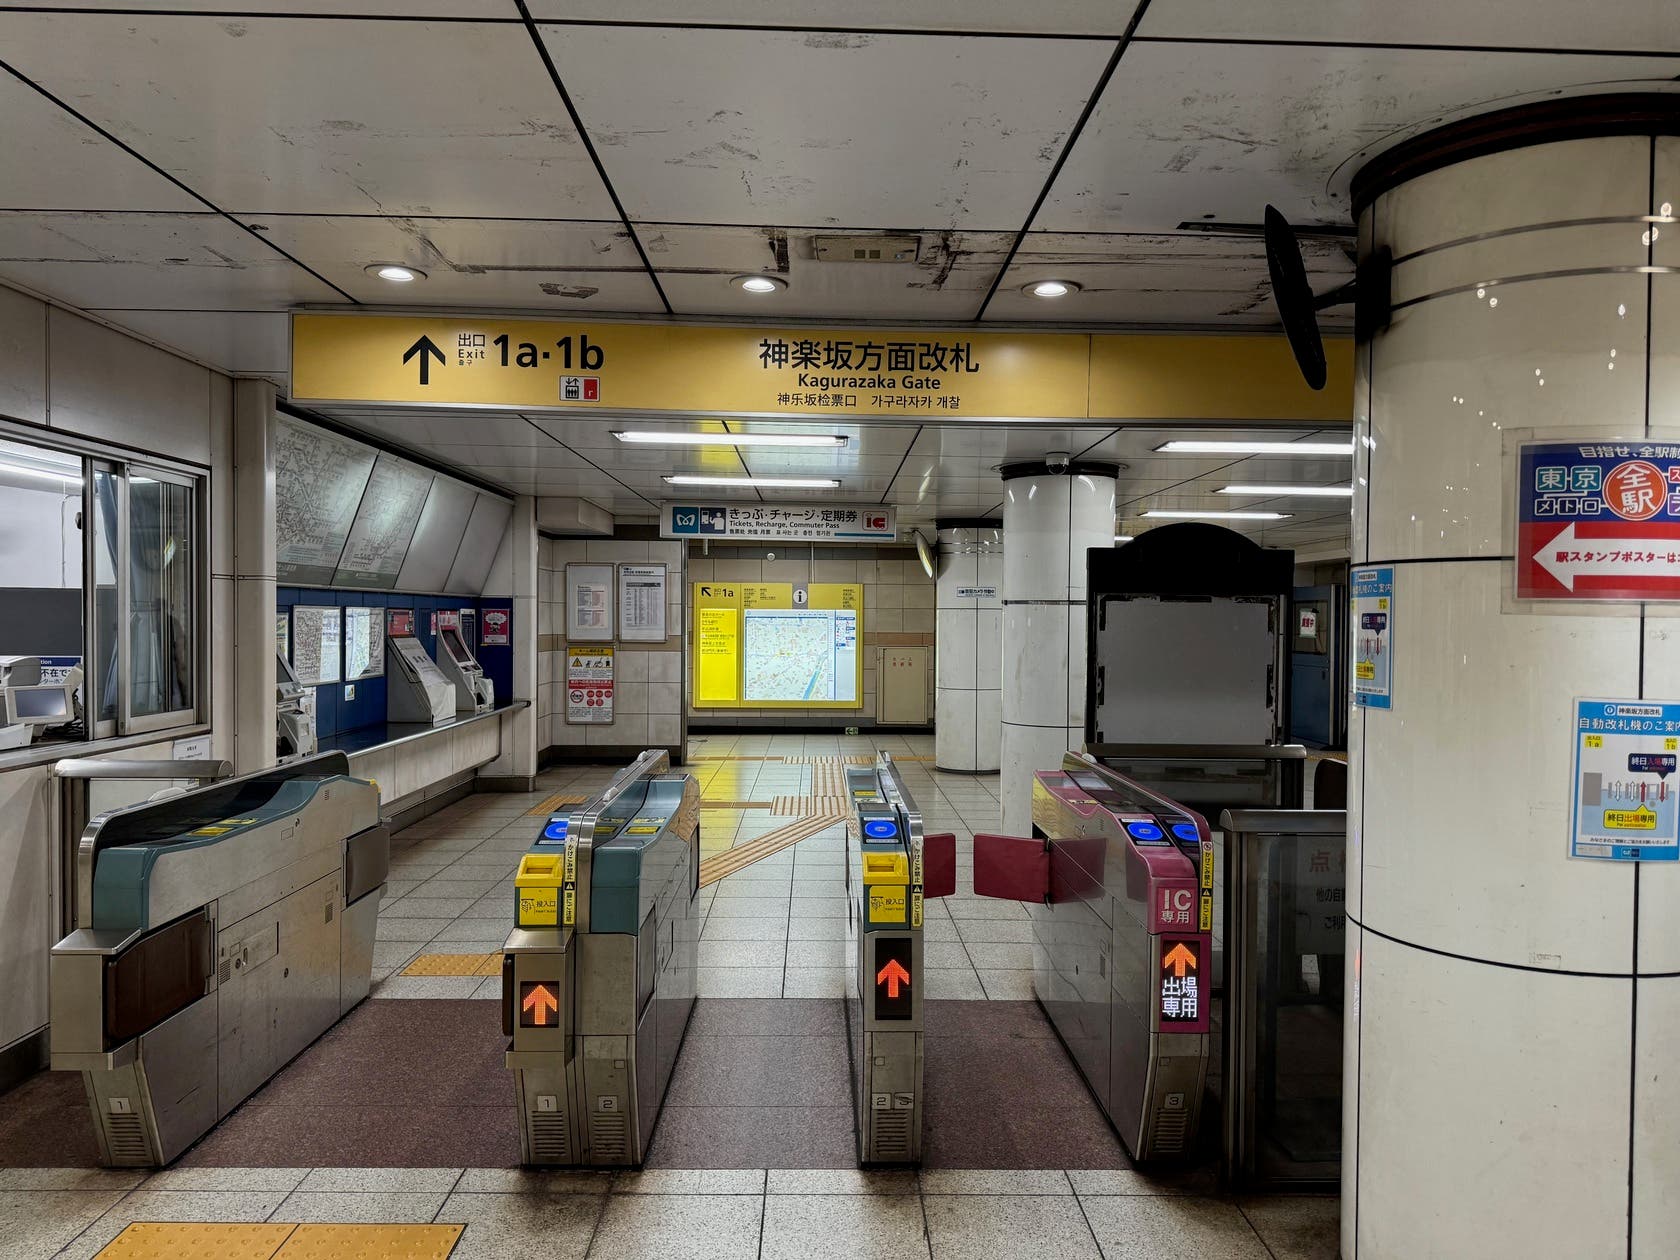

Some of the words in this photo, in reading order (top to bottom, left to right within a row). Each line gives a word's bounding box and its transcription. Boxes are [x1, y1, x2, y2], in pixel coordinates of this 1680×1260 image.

[458, 333, 486, 347] 出口
[458, 348, 485, 359] Exit
[759, 338, 980, 373] 神楽坂方面改札
[798, 373, 896, 391] Kagurazaka
[902, 375, 941, 390] Gate
[777, 392, 857, 407] 神乐坂检票口
[871, 394, 932, 409] 가구라자카
[937, 395, 961, 409] 개찰
[1539, 469, 1598, 489] 東京
[1617, 464, 1657, 514] 全駅
[1538, 501, 1597, 513] メトロ
[729, 508, 858, 523] きっぷ・チャージ・定期券
[789, 521, 824, 529] Commuter
[1556, 550, 1680, 563] 駅スタンプポスターは
[722, 588, 734, 597] 1a
[1607, 813, 1655, 824] 終日出場専用
[1164, 889, 1192, 911] IC
[1161, 910, 1190, 924] 専用
[1162, 976, 1198, 998] 出場
[1162, 997, 1198, 1018] 専用
[117, 1100, 123, 1111] 1
[544, 1098, 550, 1108] 1
[603, 1099, 613, 1109] 2
[876, 1096, 887, 1106] 2
[1169, 1096, 1179, 1105] 3
